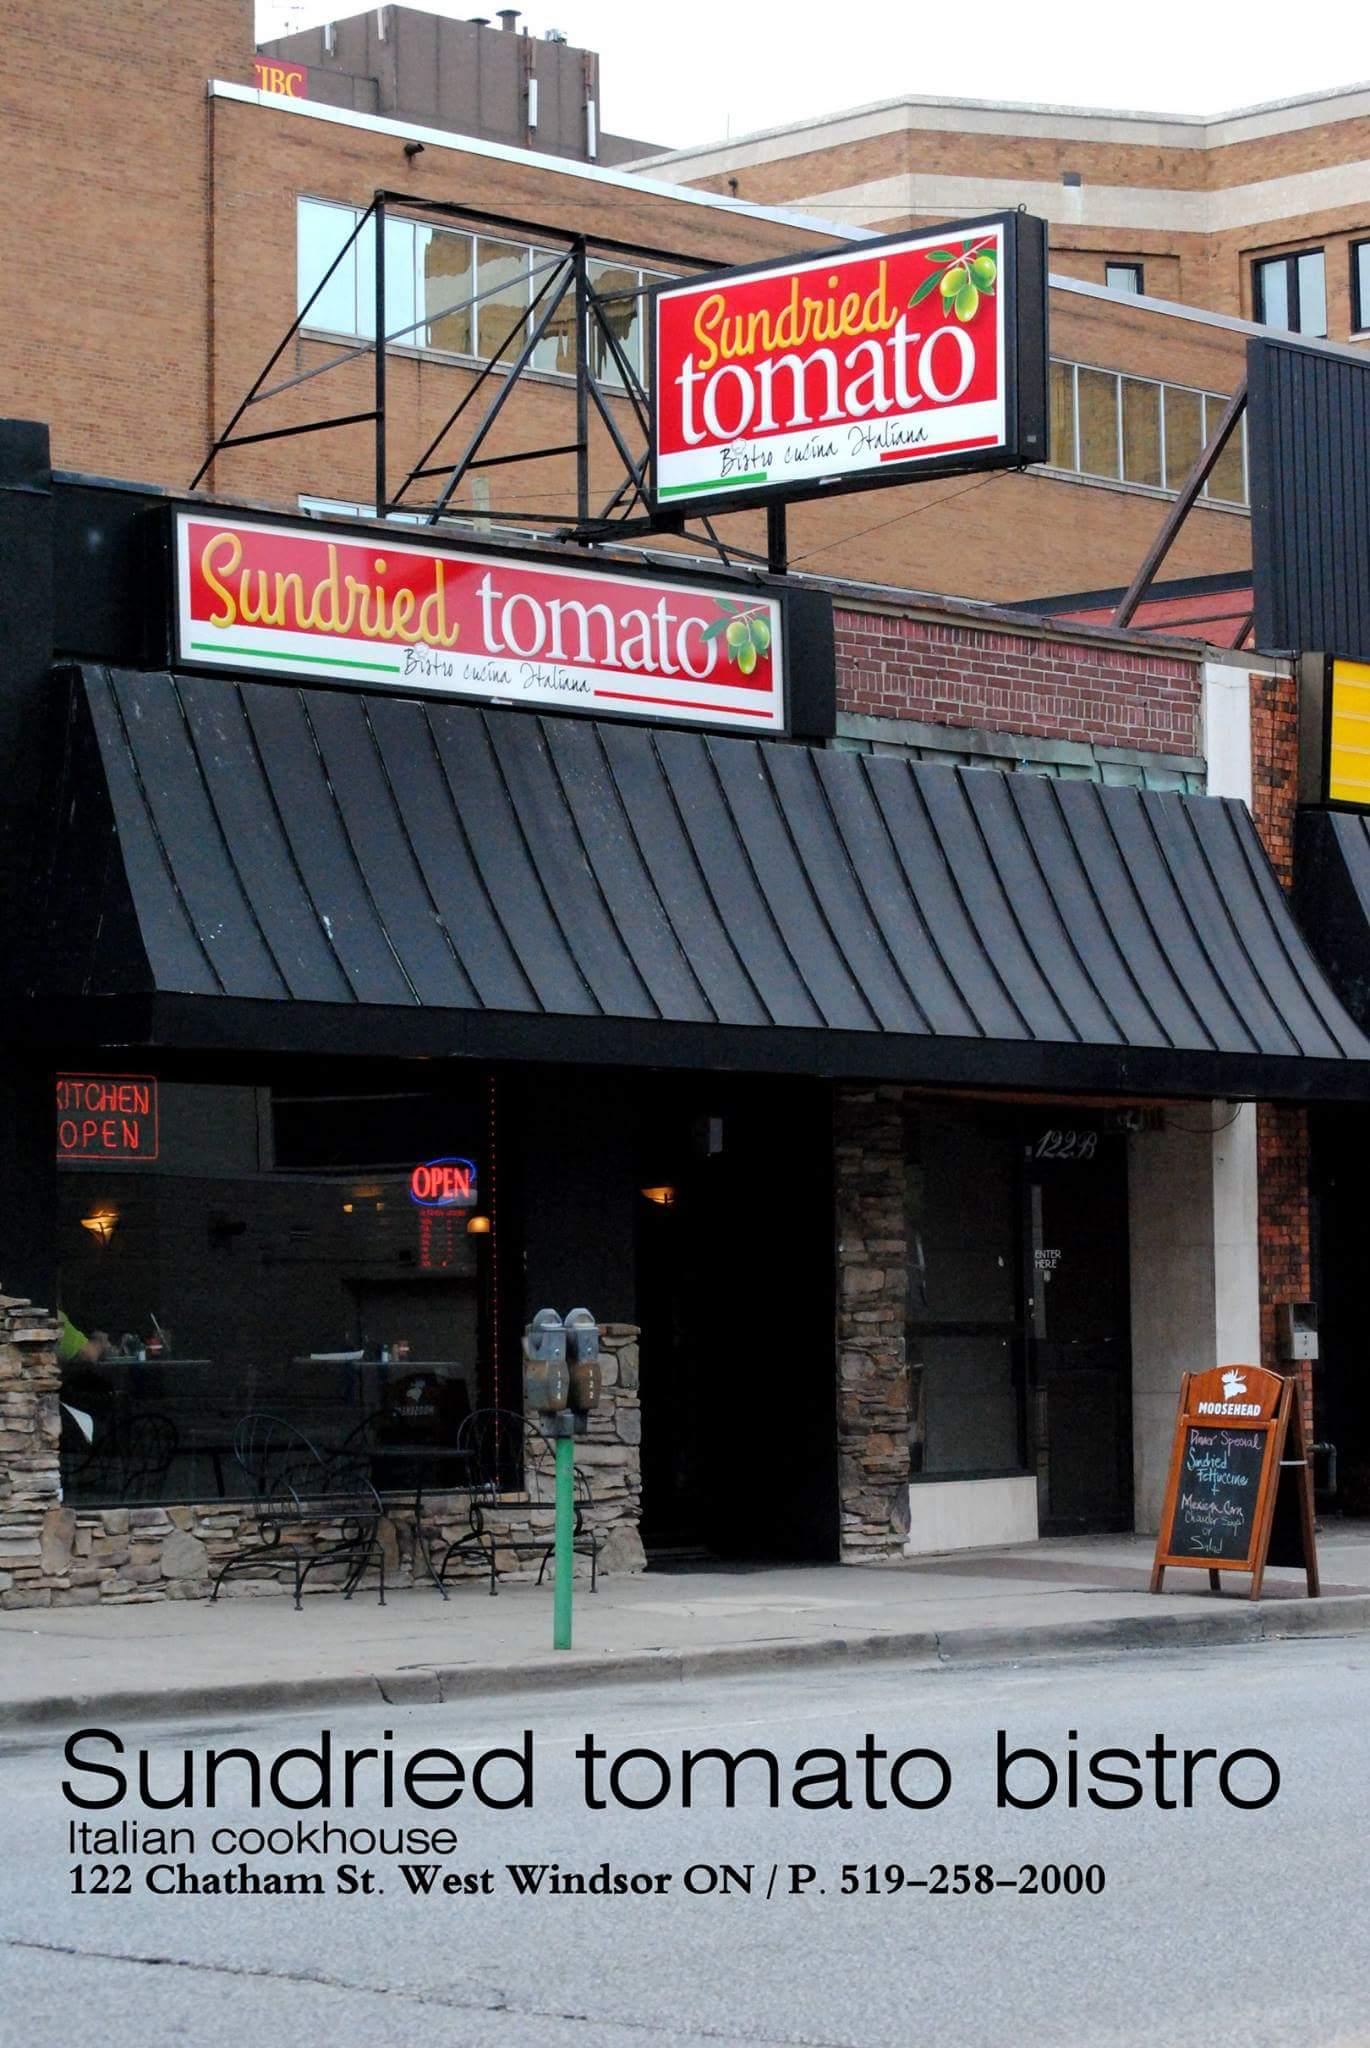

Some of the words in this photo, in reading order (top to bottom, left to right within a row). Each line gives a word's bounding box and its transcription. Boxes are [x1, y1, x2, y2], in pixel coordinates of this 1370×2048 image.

[255, 64, 302, 97] IBC
[694, 260, 898, 370] Sundried
[674, 313, 976, 445] tomato
[719, 447, 774, 477] Bistro
[784, 436, 839, 464] cucina
[847, 422, 929, 456] Italiana
[201, 532, 459, 647] Sundried
[475, 571, 718, 679] tomato
[403, 648, 453, 678] Bistro
[464, 661, 512, 685] cucina
[519, 663, 591, 694] Italiana
[60, 1120, 138, 1149] OPEN
[412, 1166, 470, 1198] OPEN
[1034, 1249, 1062, 1260] ENTER
[1034, 1258, 1057, 1269] HERE
[1198, 1402, 1261, 1416] MOOSEHEAD
[1220, 1430, 1262, 1457] Special
